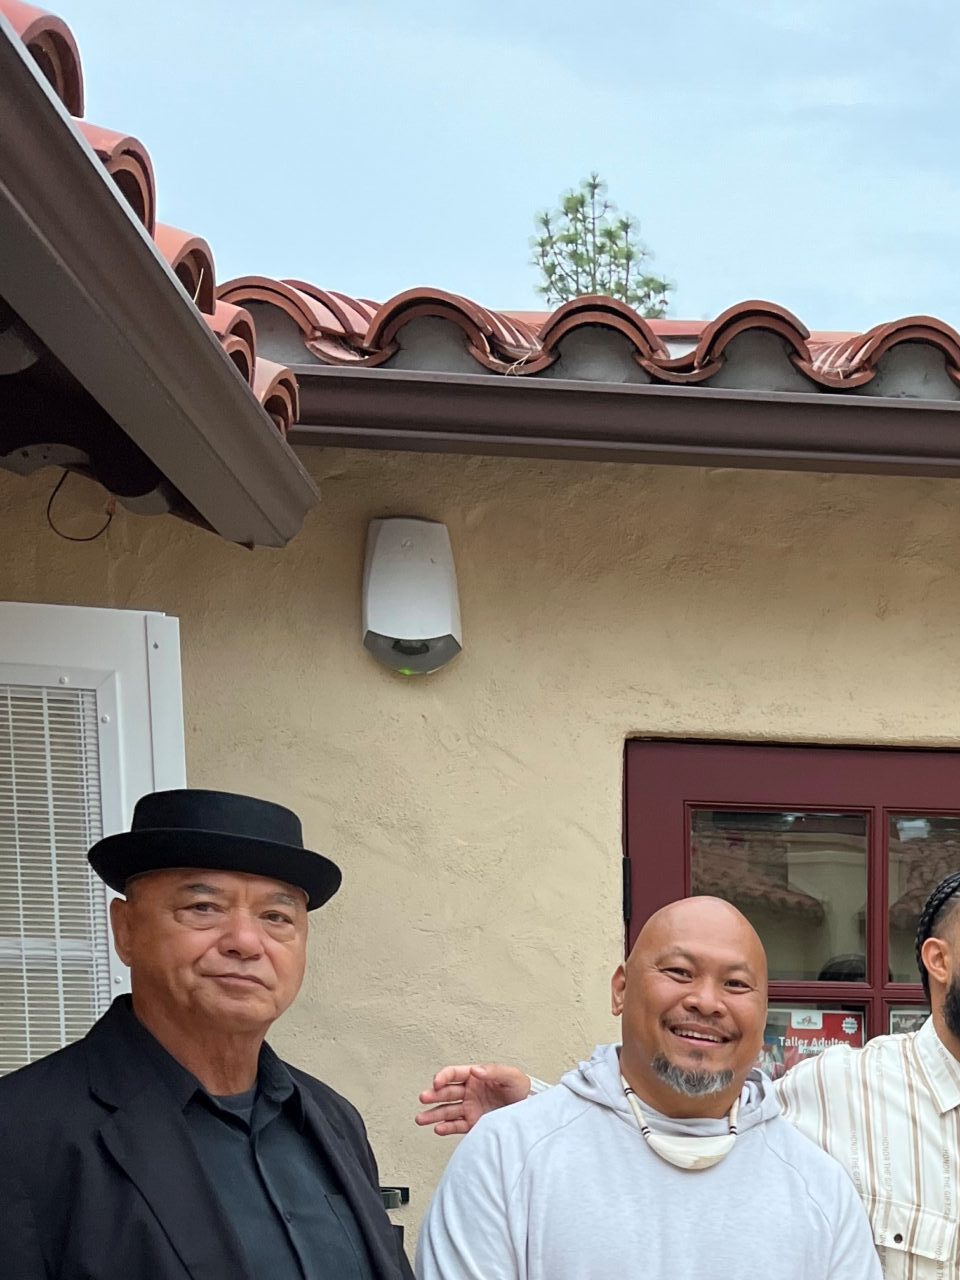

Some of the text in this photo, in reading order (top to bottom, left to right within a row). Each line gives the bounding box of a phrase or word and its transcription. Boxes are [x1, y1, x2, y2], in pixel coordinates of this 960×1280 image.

[778, 1036, 809, 1047] Taller
[882, 1136, 890, 1161] HONOR
[883, 1162, 892, 1176] THE
